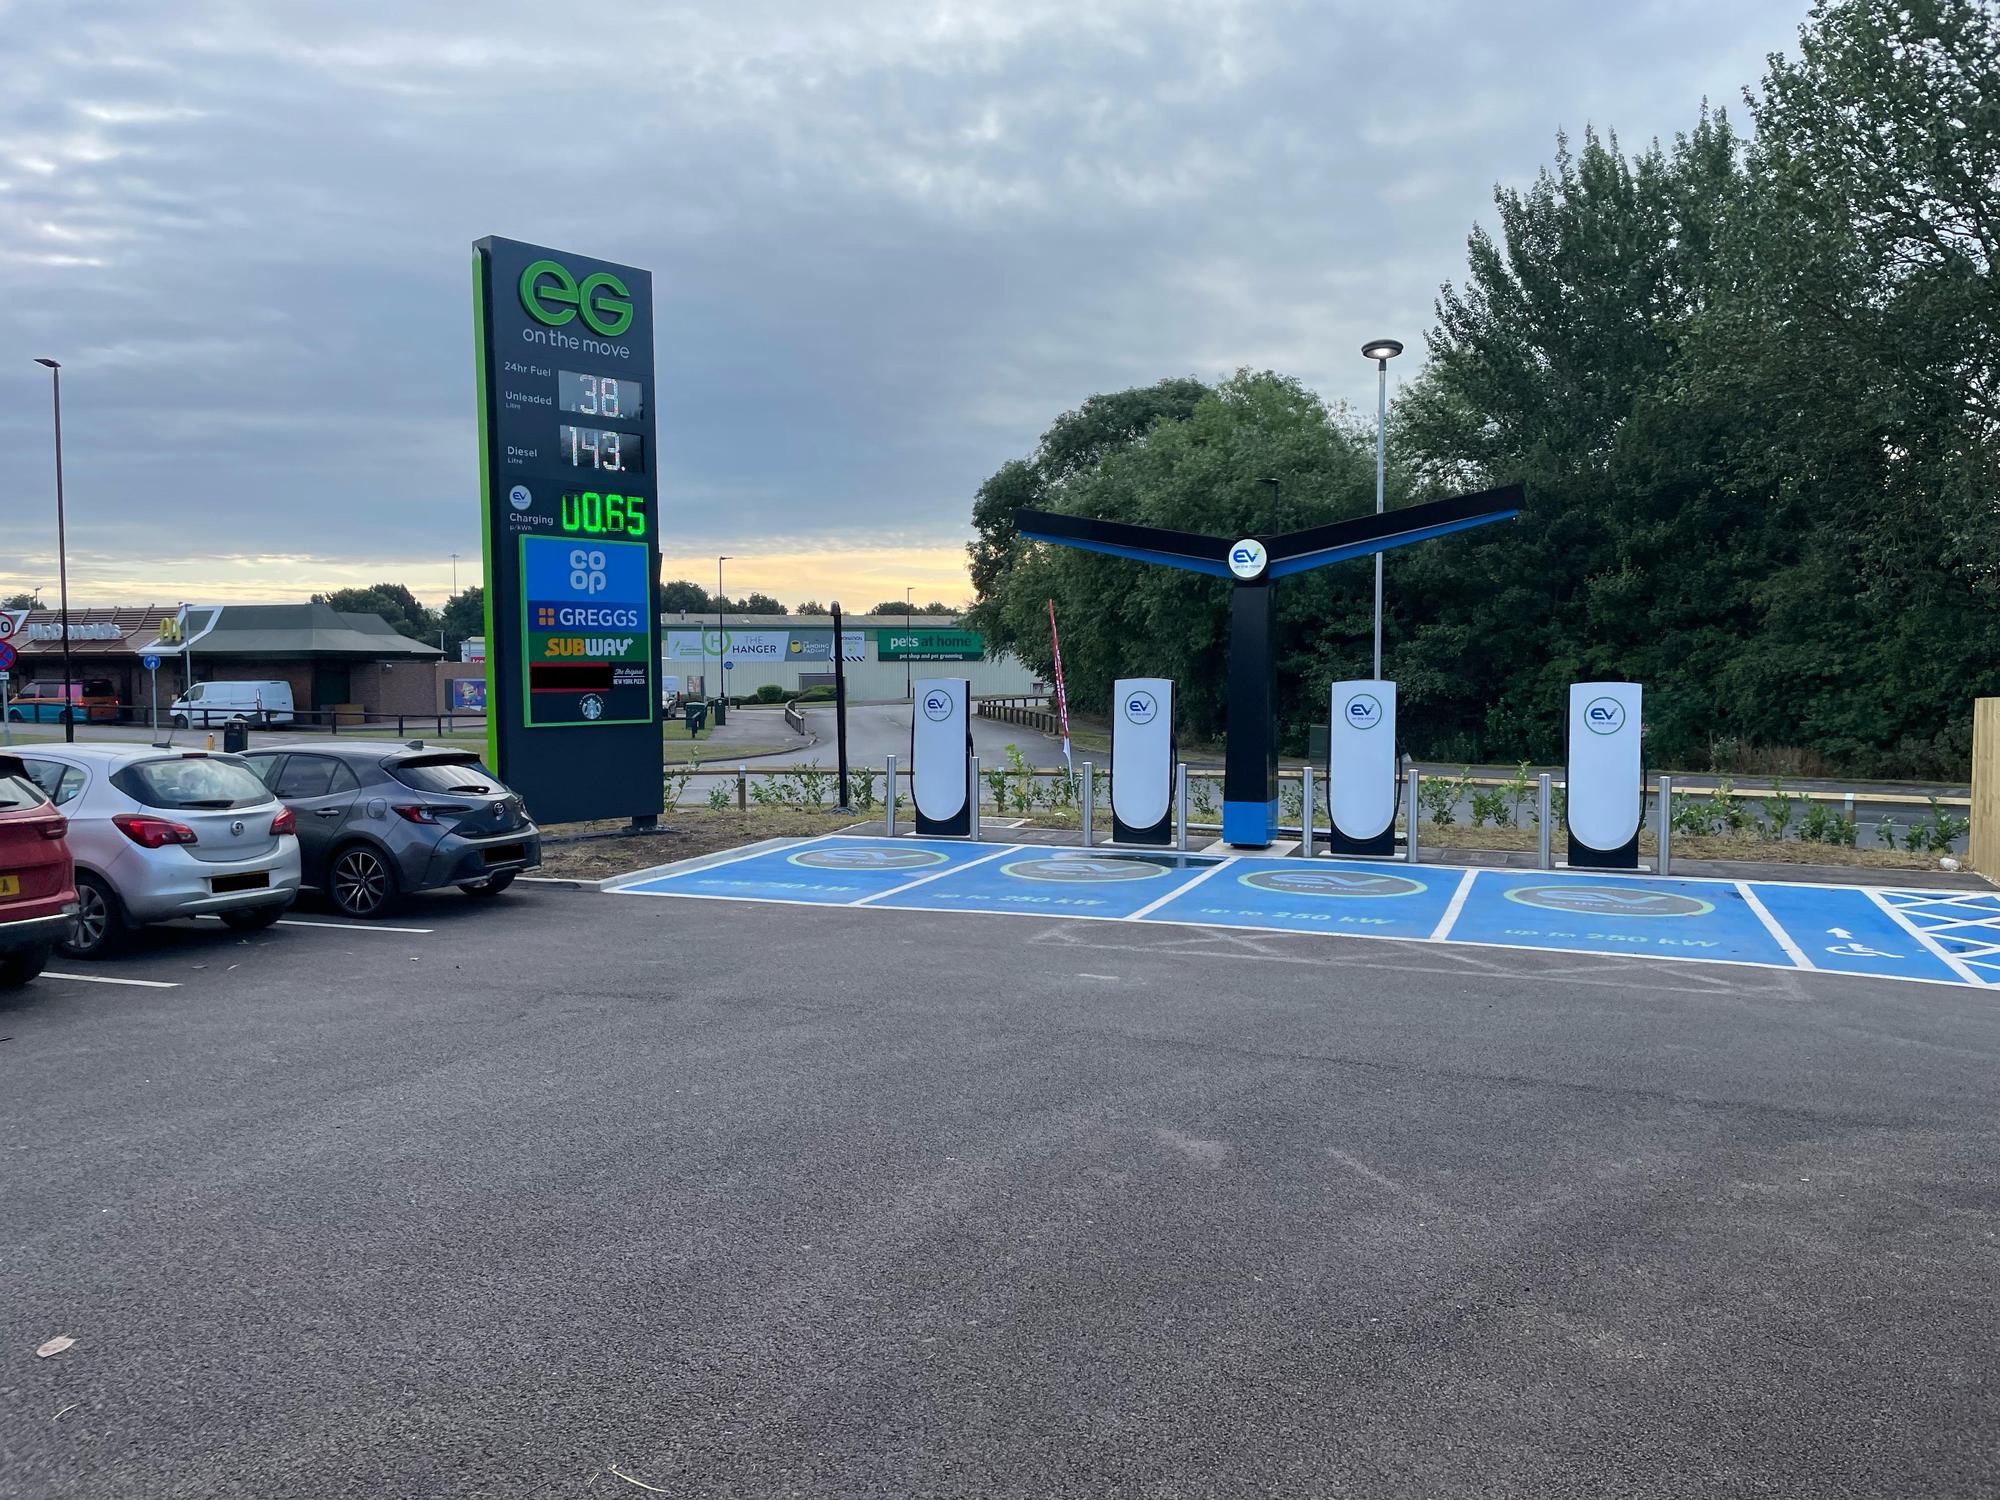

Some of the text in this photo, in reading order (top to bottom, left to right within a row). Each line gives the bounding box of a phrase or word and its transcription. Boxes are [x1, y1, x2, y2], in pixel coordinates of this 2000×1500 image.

[522, 328, 630, 359] on the move
[504, 361, 551, 377] 24hr Fuel
[505, 390, 552, 406] Unleaded
[507, 446, 538, 458] Diesel
[509, 512, 554, 526] Charging
[1232, 548, 1261, 564] EV
[559, 607, 638, 627] GREGGS
[0, 621, 11, 633] 0
[544, 637, 634, 656] SUBWAY
[732, 644, 777, 654] HANGER
[890, 634, 972, 650] pets at home
[927, 698, 948, 709] EV
[1129, 700, 1151, 712] EV
[1350, 703, 1375, 716] EV
[1590, 707, 1619, 721] EV
[1271, 910, 1332, 921] 250
[1337, 915, 1397, 925] kW
[1503, 929, 1540, 937] up
[1584, 932, 1649, 944] 250
[1656, 937, 1721, 948] kW
